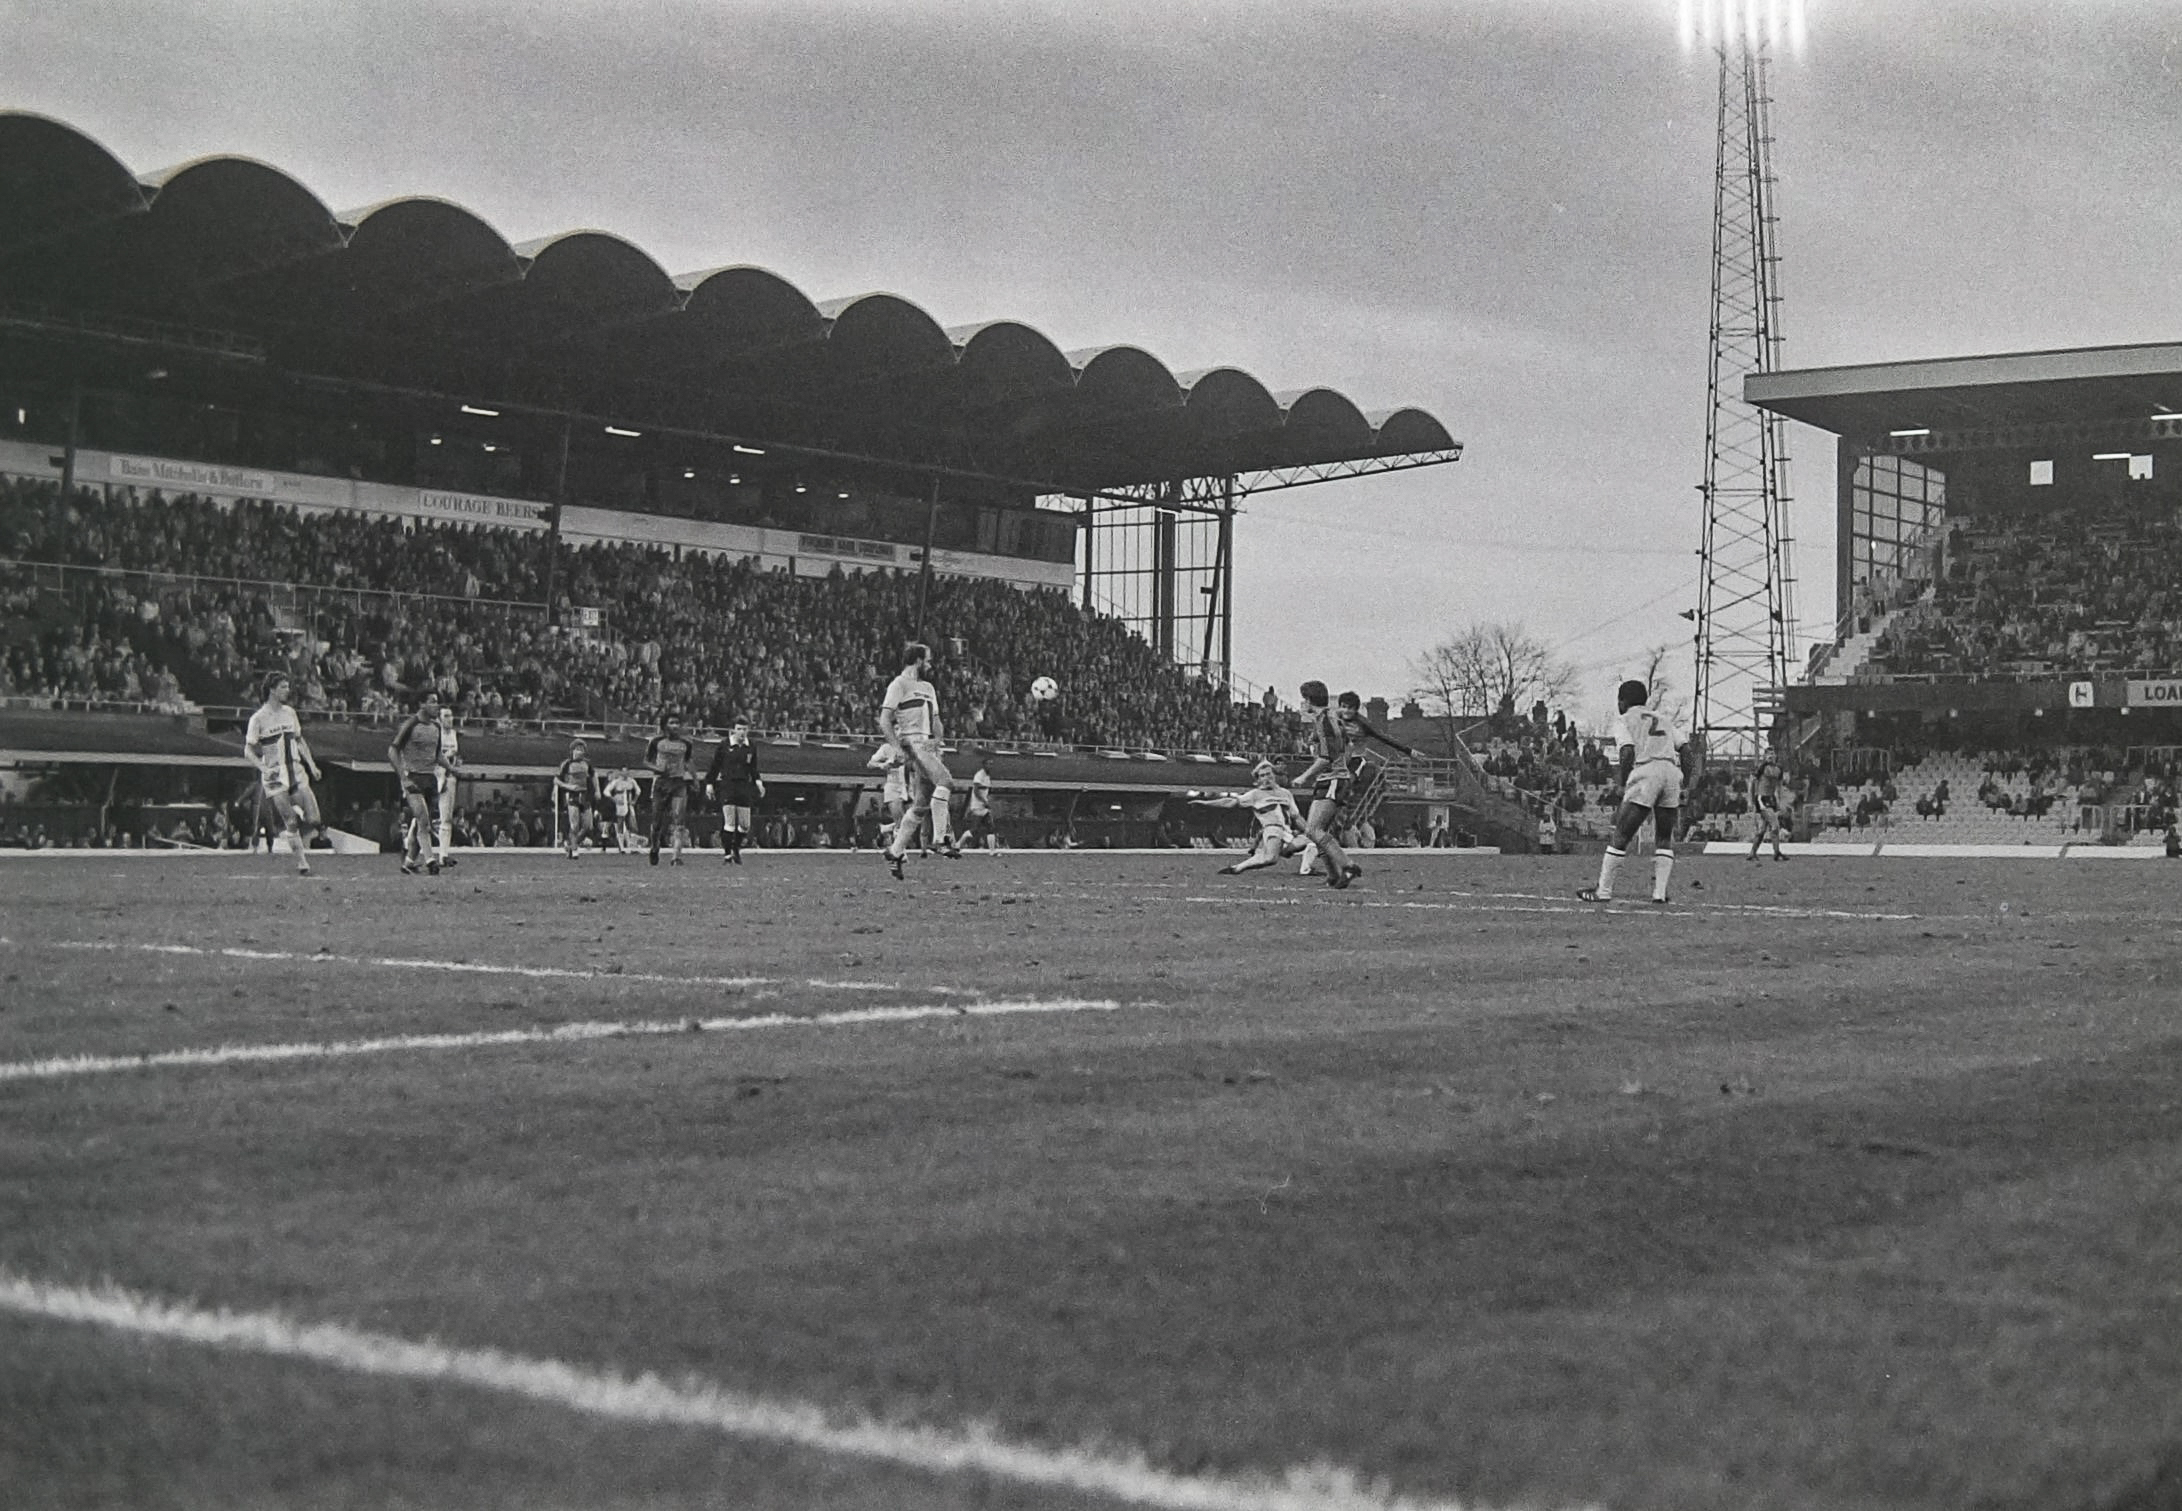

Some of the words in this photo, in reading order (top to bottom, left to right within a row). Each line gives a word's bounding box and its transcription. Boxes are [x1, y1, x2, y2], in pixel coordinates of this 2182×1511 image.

[423, 494, 488, 514] COURAGE
[495, 502, 537, 519] BEERS
[2144, 686, 2182, 701] LOA
[1641, 713, 1667, 737] 2
